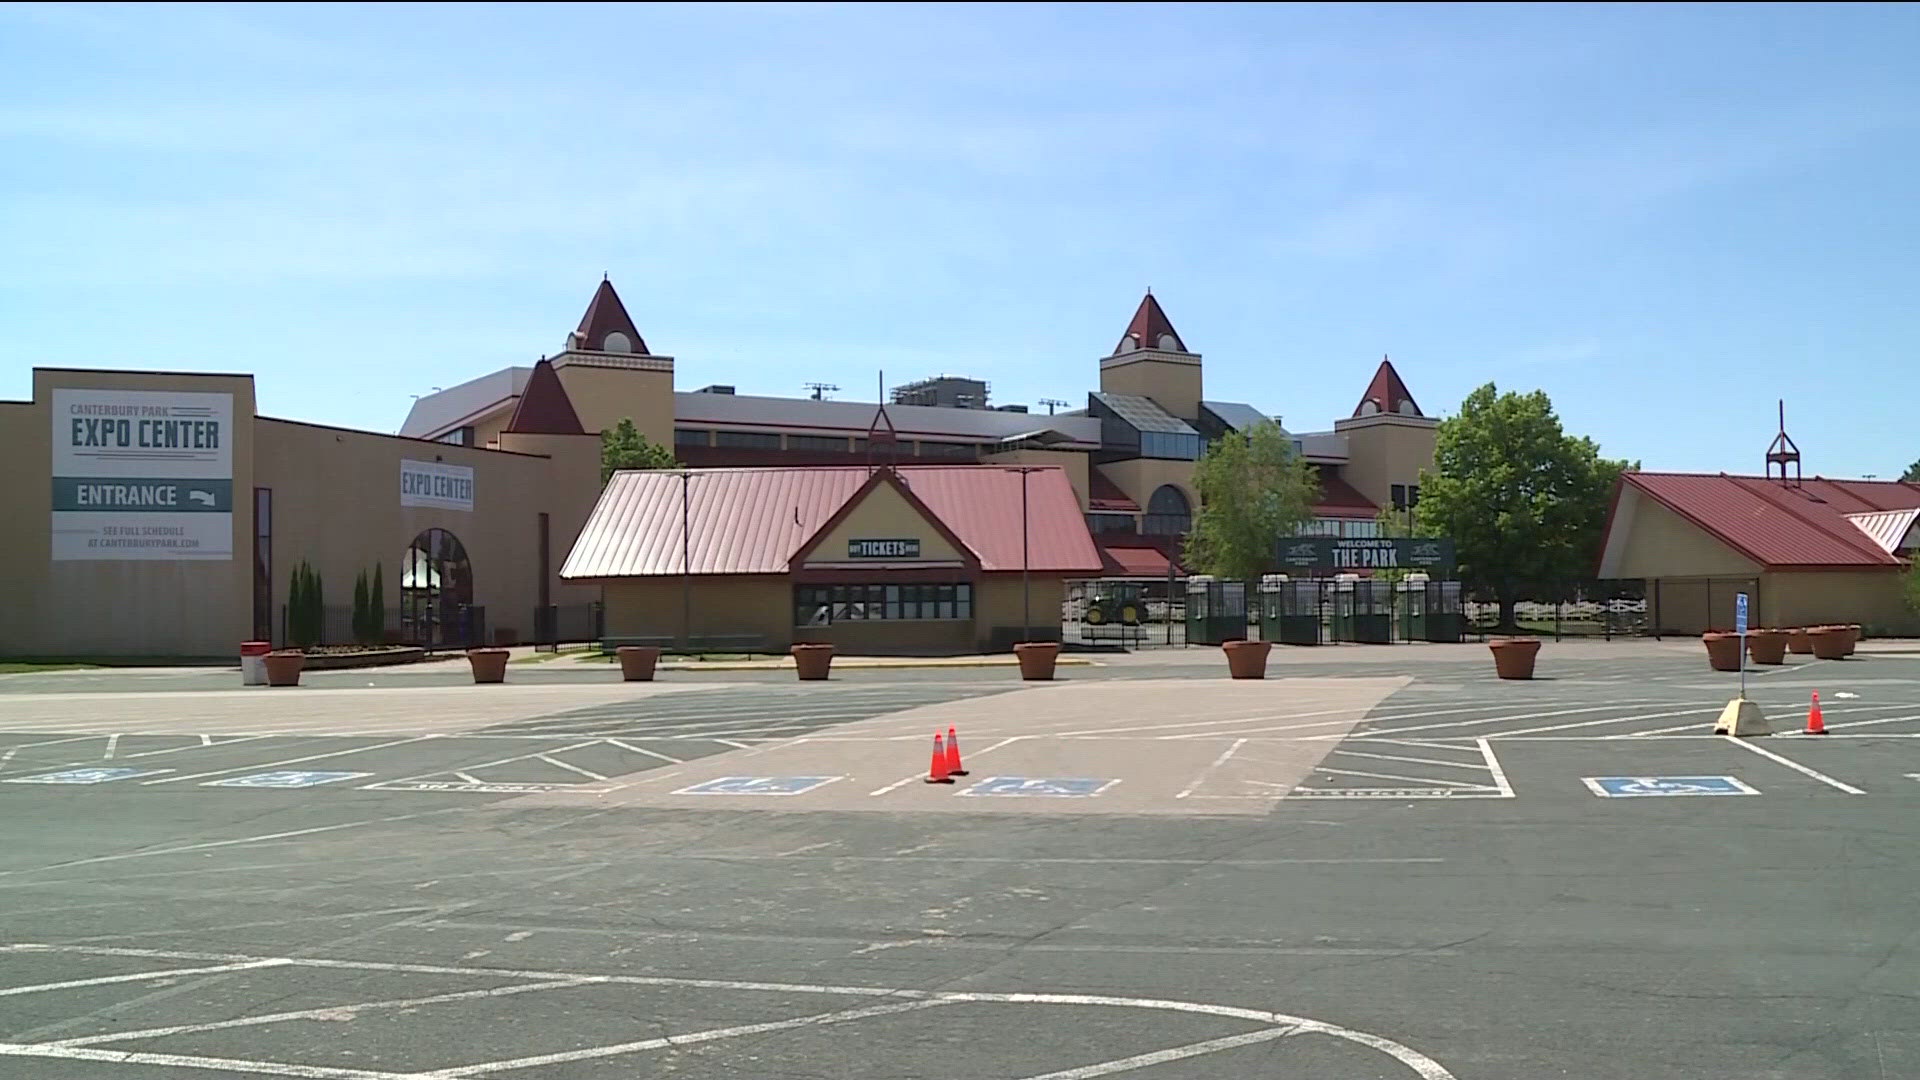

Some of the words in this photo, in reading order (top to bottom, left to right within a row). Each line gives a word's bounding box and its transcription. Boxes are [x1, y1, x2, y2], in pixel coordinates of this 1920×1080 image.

[70, 404, 141, 417] CANTERBURY
[142, 406, 169, 417] PARK
[71, 418, 130, 447] EXPO
[138, 420, 219, 449] CENTER
[402, 472, 431, 495] EXPO
[434, 475, 472, 499] CENTER
[77, 485, 177, 505] ENTRANCE
[103, 526, 117, 535] SEE
[119, 526, 140, 536] FULL
[142, 527, 184, 536] SCHEDULE
[99, 538, 199, 548] CANTERBURYPARK.COM
[861, 542, 905, 555] TICKETS
[1337, 540, 1380, 548] WELCOME
[1381, 540, 1393, 548] TO
[1332, 549, 1358, 567] THE
[1362, 549, 1397, 567] PARK
